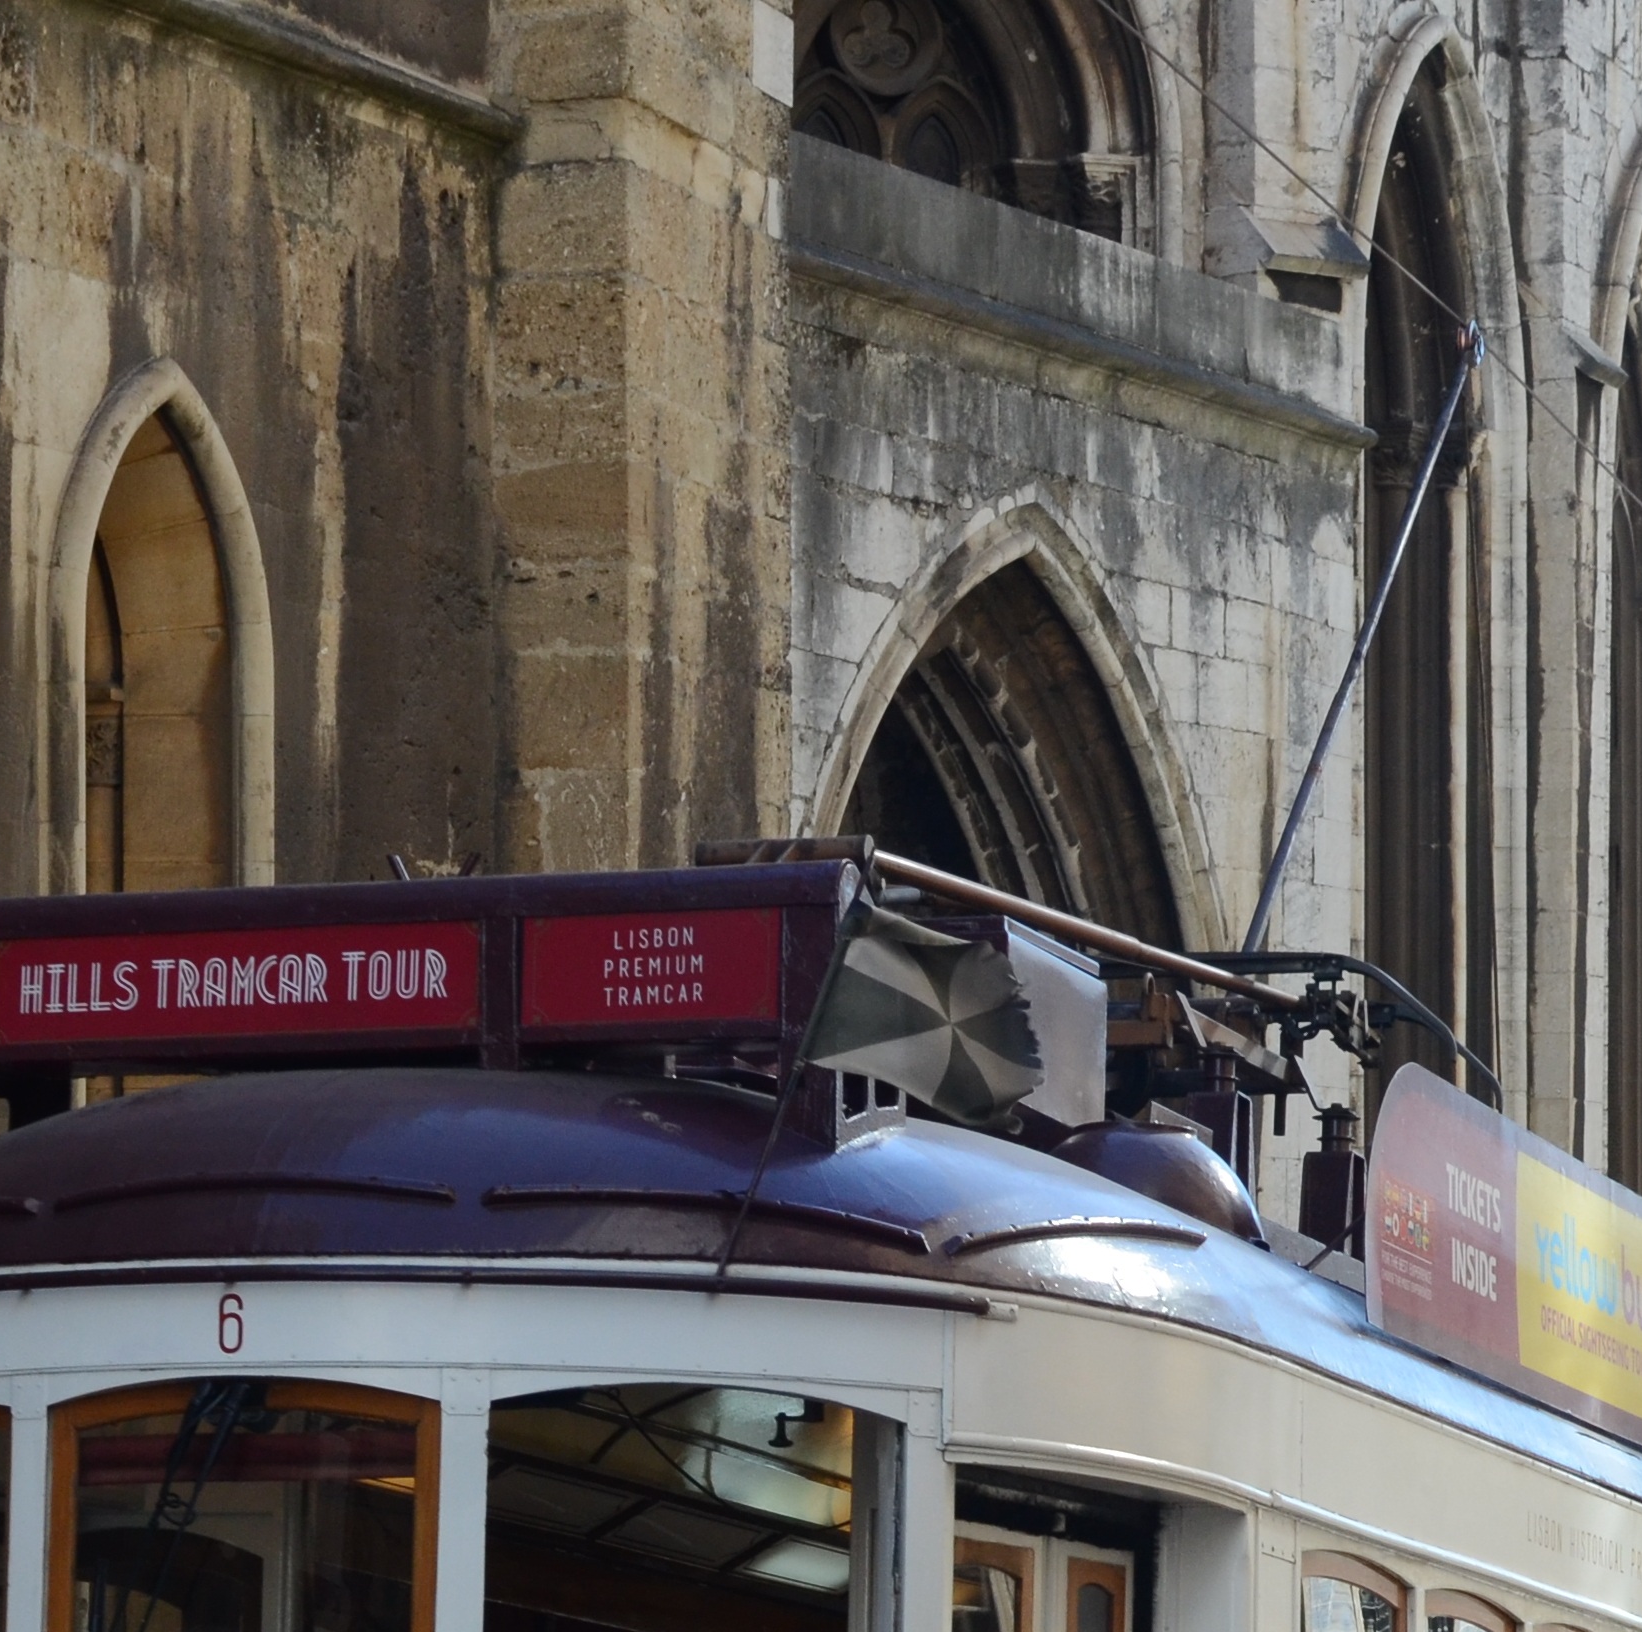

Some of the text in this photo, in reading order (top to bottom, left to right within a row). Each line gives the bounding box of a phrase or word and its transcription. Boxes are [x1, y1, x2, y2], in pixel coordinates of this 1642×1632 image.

[604, 954, 703, 979] PREMIUM
[614, 926, 694, 950] LISBON
[20, 948, 447, 1014] HILLS TRAMCAR TOUR
[603, 983, 703, 1007] TRAMCAR
[1446, 1162, 1501, 1234] TICKETS
[1451, 1237, 1497, 1301] INSIDE
[219, 1293, 243, 1353] 6
[1540, 1304, 1577, 1347] OFFICIAL
[1578, 1322, 1630, 1371] SIGHTSEEING
[1527, 1510, 1563, 1553] LISBON
[1569, 1527, 1625, 1574] HISTORICAL
